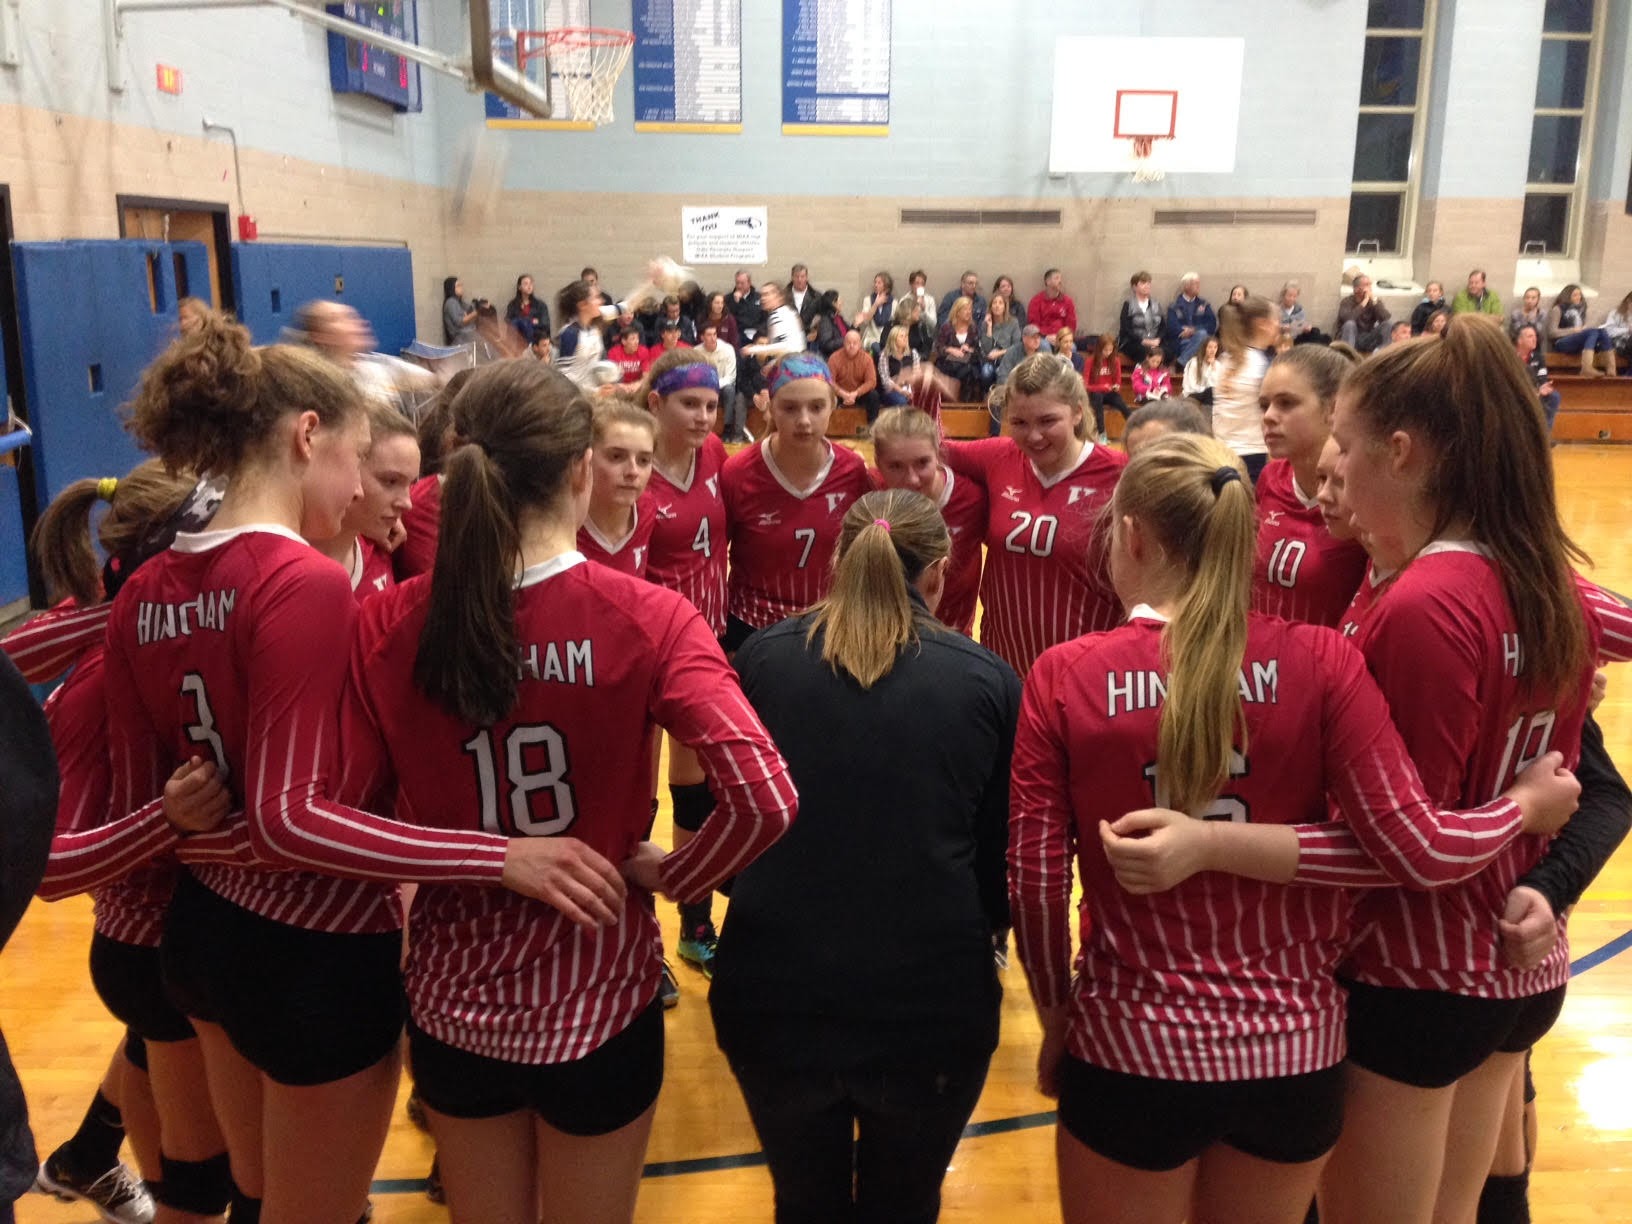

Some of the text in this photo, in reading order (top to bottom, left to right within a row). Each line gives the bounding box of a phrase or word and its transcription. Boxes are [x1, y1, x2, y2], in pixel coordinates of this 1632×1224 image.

[691, 211, 719, 224] THANK
[702, 223, 717, 232] YOU
[691, 516, 712, 558] 4
[795, 528, 816, 568] 7
[1005, 510, 1058, 557] 20
[1267, 537, 1306, 588] 10
[1107, 658, 1279, 718] HINAM
[180, 673, 230, 780] 3
[463, 722, 578, 837] 18
